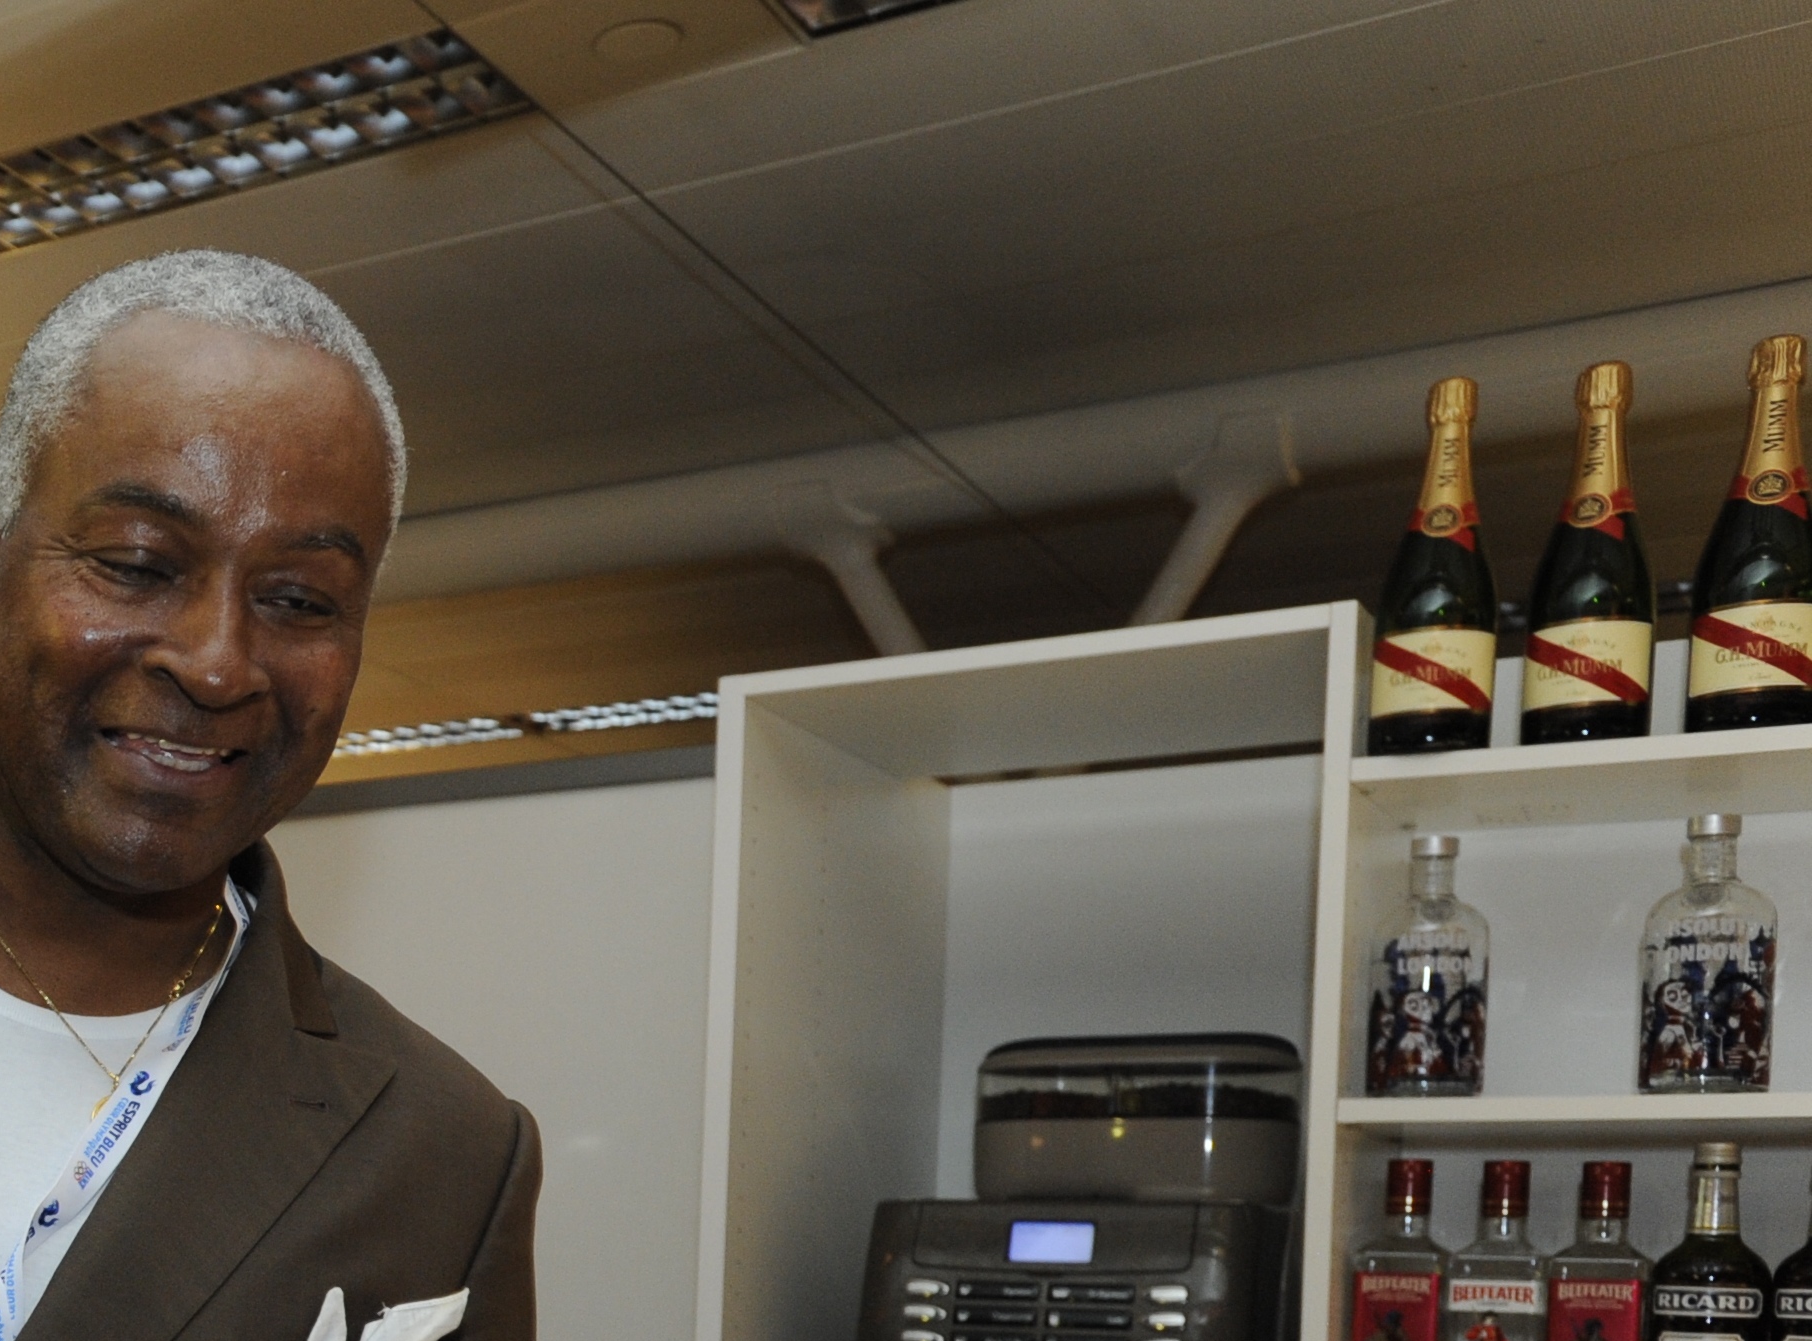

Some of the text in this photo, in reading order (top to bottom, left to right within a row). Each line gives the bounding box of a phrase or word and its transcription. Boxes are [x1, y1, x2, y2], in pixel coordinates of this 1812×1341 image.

[1762, 398, 1787, 453] MUMM
[1583, 423, 1608, 478] MUMM
[1438, 437, 1460, 488] MUMM
[1745, 641, 1809, 659] MUMM
[1562, 657, 1624, 677] MUMM
[1662, 942, 1745, 964] ONDON
[109, 1099, 142, 1141] ESPRIT
[90, 1136, 116, 1168] BLEU
[1361, 1275, 1432, 1293] BEEFEATER
[1452, 1285, 1535, 1304] BEEFEATER
[1557, 1281, 1634, 1302] BEEFEATER
[1657, 1292, 1755, 1311] RICARD
